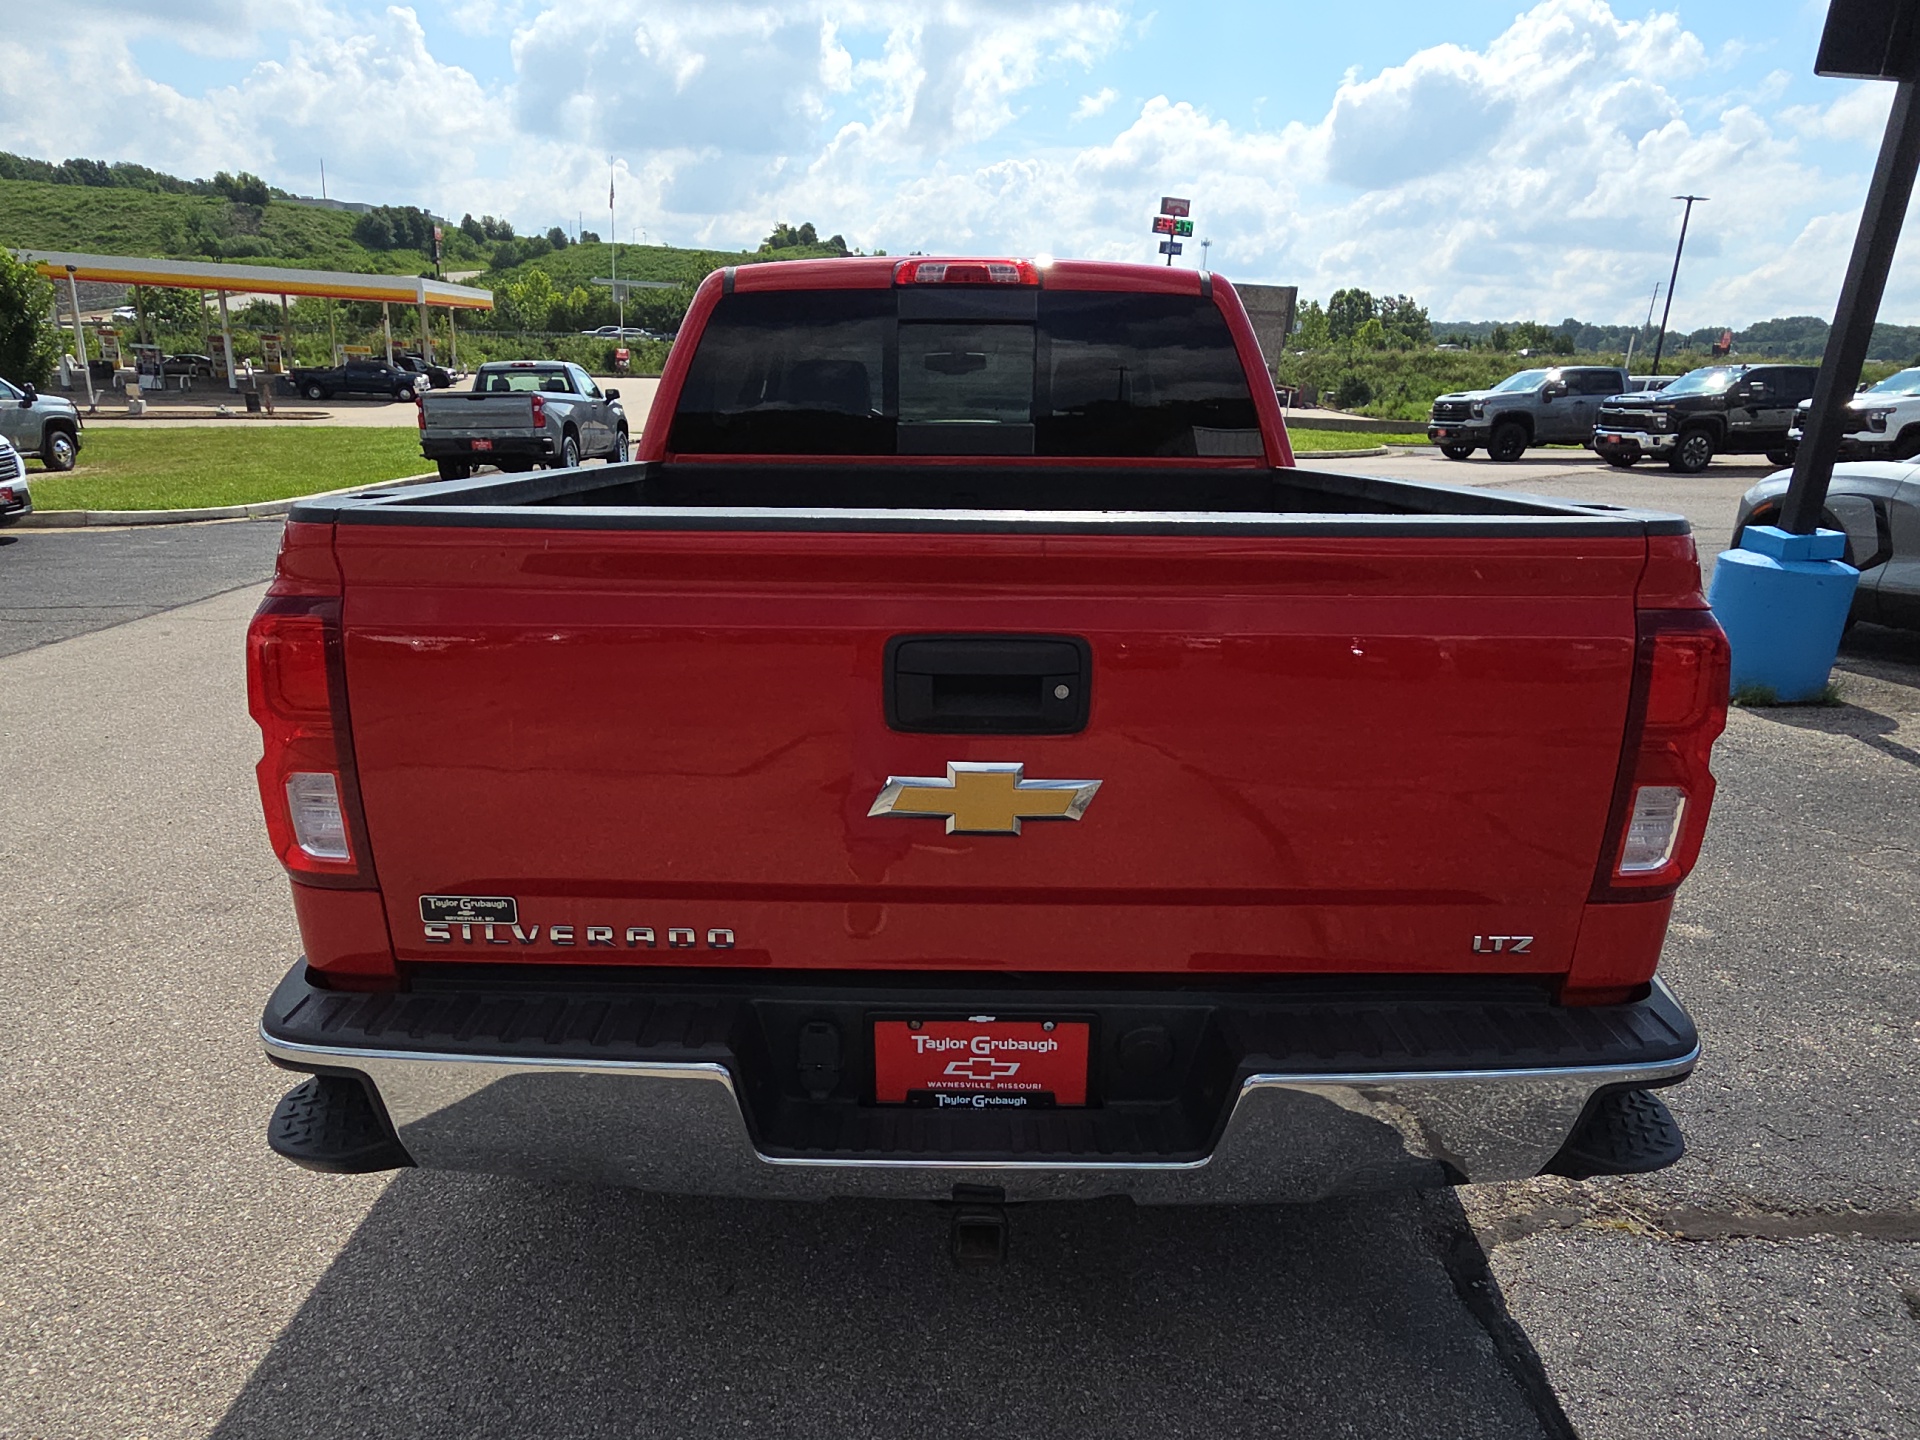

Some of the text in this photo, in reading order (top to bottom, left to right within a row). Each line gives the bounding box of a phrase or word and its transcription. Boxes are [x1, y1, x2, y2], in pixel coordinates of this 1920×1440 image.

[427, 898, 508, 909] Taylor Grubaugh
[424, 923, 735, 948] SILVERADO
[1473, 935, 1534, 954] LTZ
[911, 1035, 1058, 1054] Taylor Grubaugh
[927, 1081, 995, 1090] WAYNESVILLE,
[935, 1094, 1027, 1108] Taylor Grubaugh
